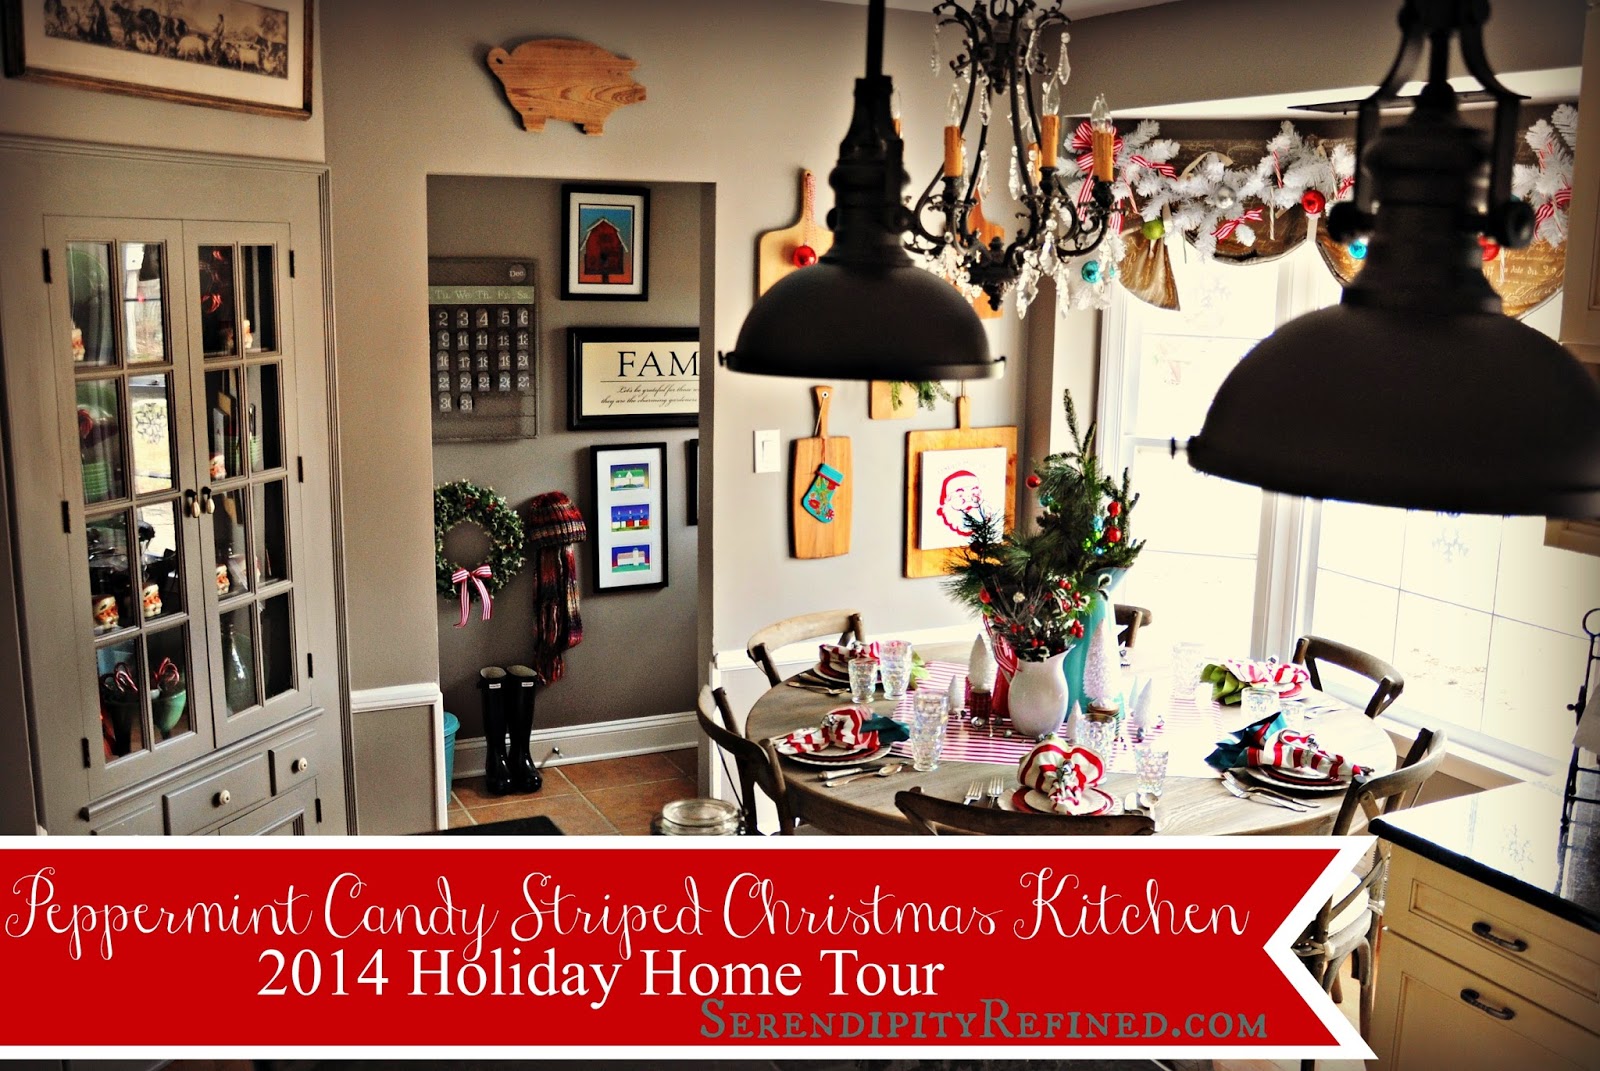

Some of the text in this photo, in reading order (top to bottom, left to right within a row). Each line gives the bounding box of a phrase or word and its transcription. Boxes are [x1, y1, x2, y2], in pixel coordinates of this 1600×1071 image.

[439, 310, 529, 326] 2 3 4 5 6
[441, 332, 450, 347] 9
[477, 334, 488, 346] 11
[460, 357, 470, 368] 17
[501, 356, 511, 367] 19
[617, 351, 699, 377] FAM
[461, 399, 473, 410] 31
